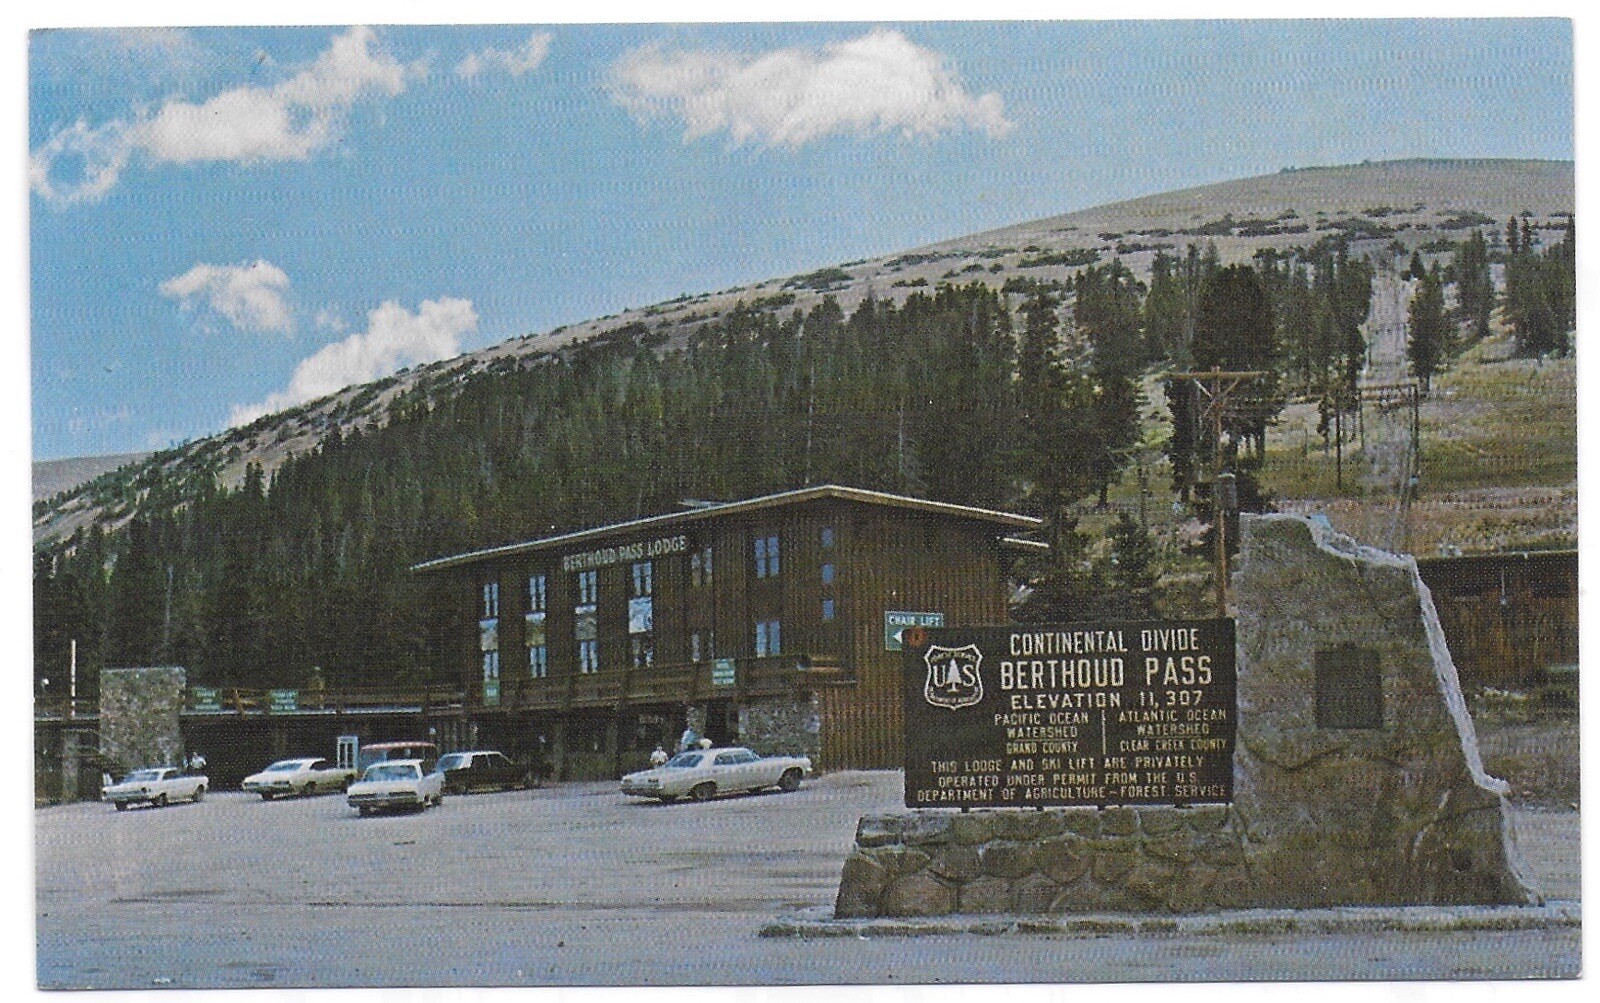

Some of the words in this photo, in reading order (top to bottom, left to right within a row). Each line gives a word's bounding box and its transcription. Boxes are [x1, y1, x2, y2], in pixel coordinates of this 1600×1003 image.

[647, 535, 686, 557] LODGE
[920, 617, 940, 627] LIFT
[1010, 631, 1128, 656] CONTINENTAL
[1141, 628, 1199, 651] DIVIDE
[1001, 658, 1124, 690] BERTHOUD
[1146, 655, 1212, 686] PASS
[1011, 692, 1121, 710] ELEVATION
[994, 713, 1041, 725] PACIFIC
[1050, 711, 1089, 724] OCEAN
[1118, 709, 1178, 723] ATLANTIC
[1187, 709, 1227, 721] OCEAN
[1006, 726, 1078, 739] WATERSHED
[1137, 723, 1210, 735] WATERSHED
[1006, 742, 1037, 754] GRAND
[1042, 741, 1078, 752] COUNTY
[1120, 740, 1149, 751] CLEAR
[1155, 739, 1185, 750] CREEK
[1190, 738, 1227, 750] COUNTY
[931, 760, 957, 773] THIS
[965, 759, 1001, 772] LODGE
[1011, 759, 1034, 771] AND
[1042, 758, 1061, 771] SKI
[1069, 757, 1095, 770] LIFT
[1104, 757, 1127, 769] ARE
[1135, 755, 1204, 768] PRIVATELY
[938, 774, 999, 788] OPERATED
[1006, 773, 1045, 786] UNDER
[1053, 773, 1096, 785] PERMIT
[1105, 772, 1137, 785] FROM
[1146, 772, 1167, 783] THE
[917, 788, 994, 802] DEPARTMENT
[1002, 787, 1016, 800] OF
[1175, 784, 1226, 797] SERVICE
